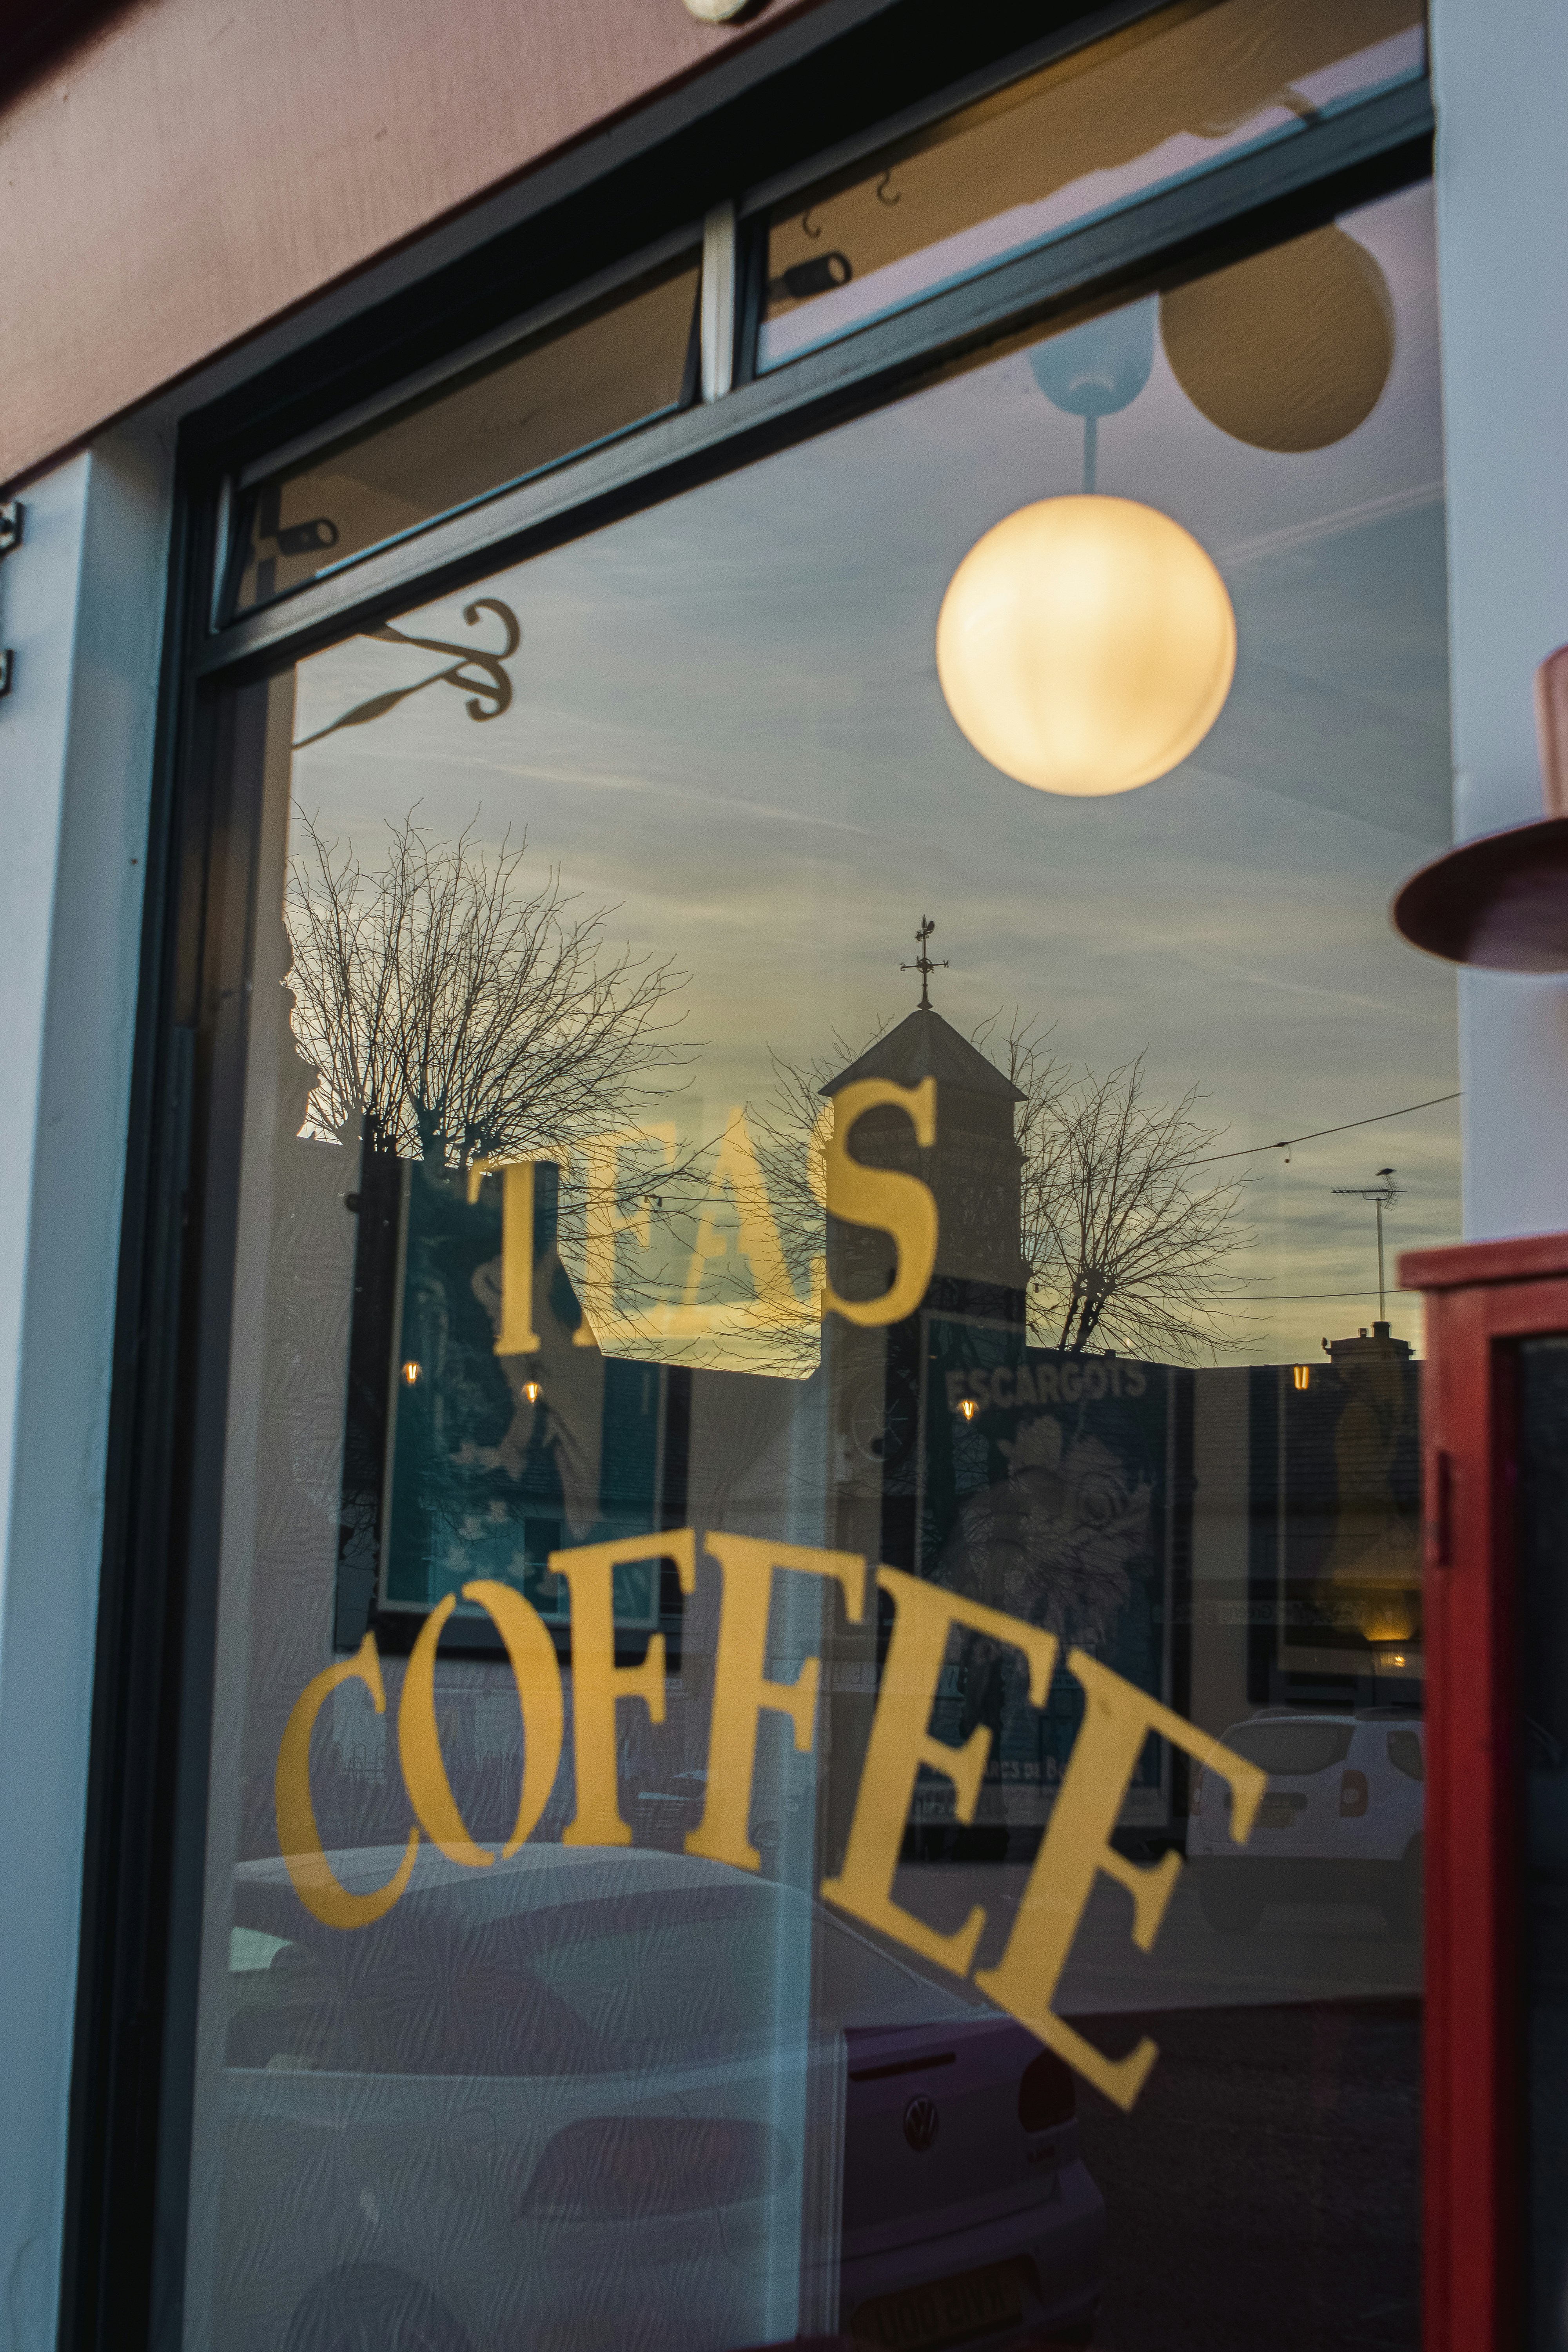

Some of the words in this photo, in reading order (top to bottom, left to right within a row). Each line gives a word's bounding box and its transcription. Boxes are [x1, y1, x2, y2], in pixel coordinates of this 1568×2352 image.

[466, 1075, 938, 1356] TEAS
[946, 1360, 1147, 1413] ESCARGOTS
[275, 1527, 1267, 2111] COFFEE
